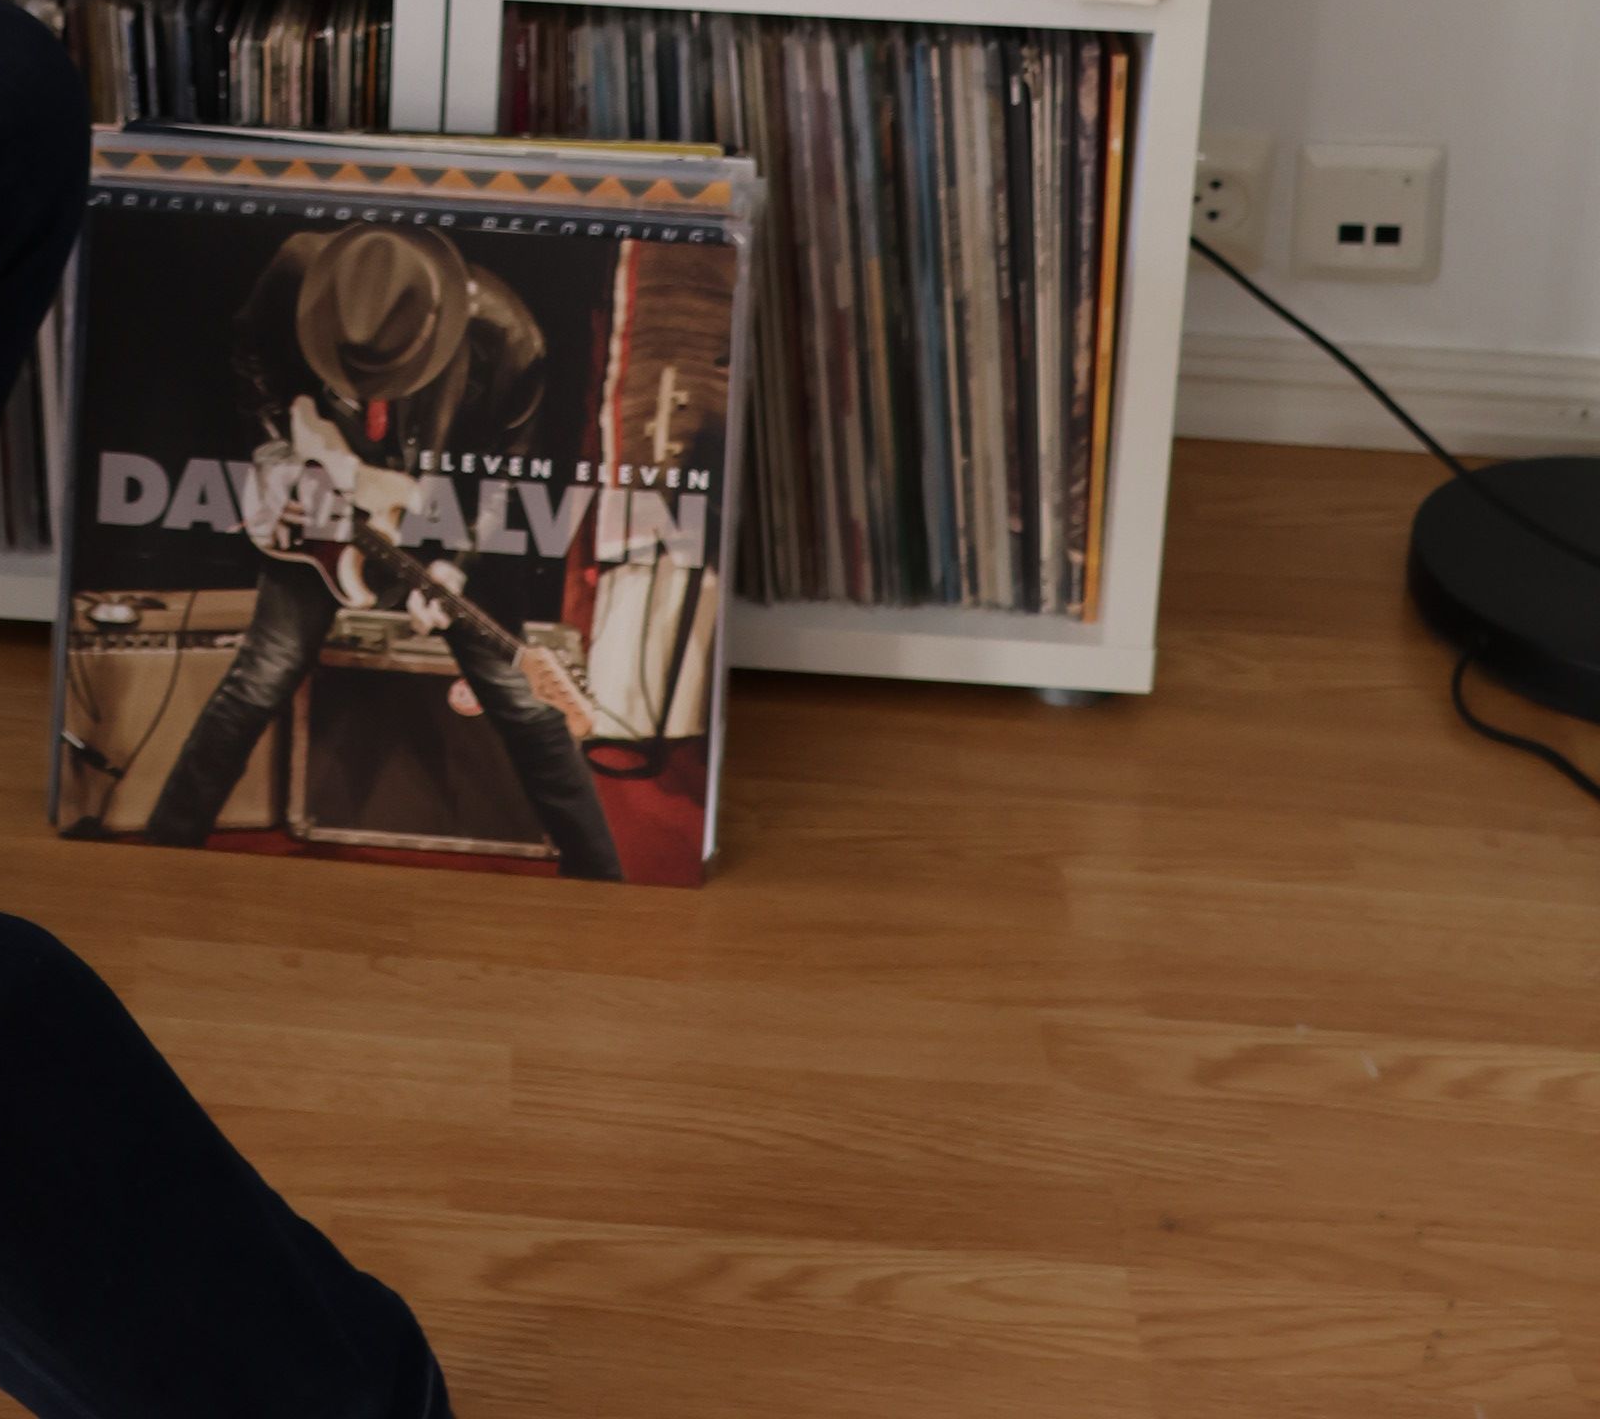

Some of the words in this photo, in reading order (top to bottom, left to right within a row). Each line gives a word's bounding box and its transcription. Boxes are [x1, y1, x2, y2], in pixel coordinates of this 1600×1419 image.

[418, 449, 554, 480] ELEVEN
[575, 461, 710, 491] ELEVEN
[399, 473, 708, 569] ALVIN
